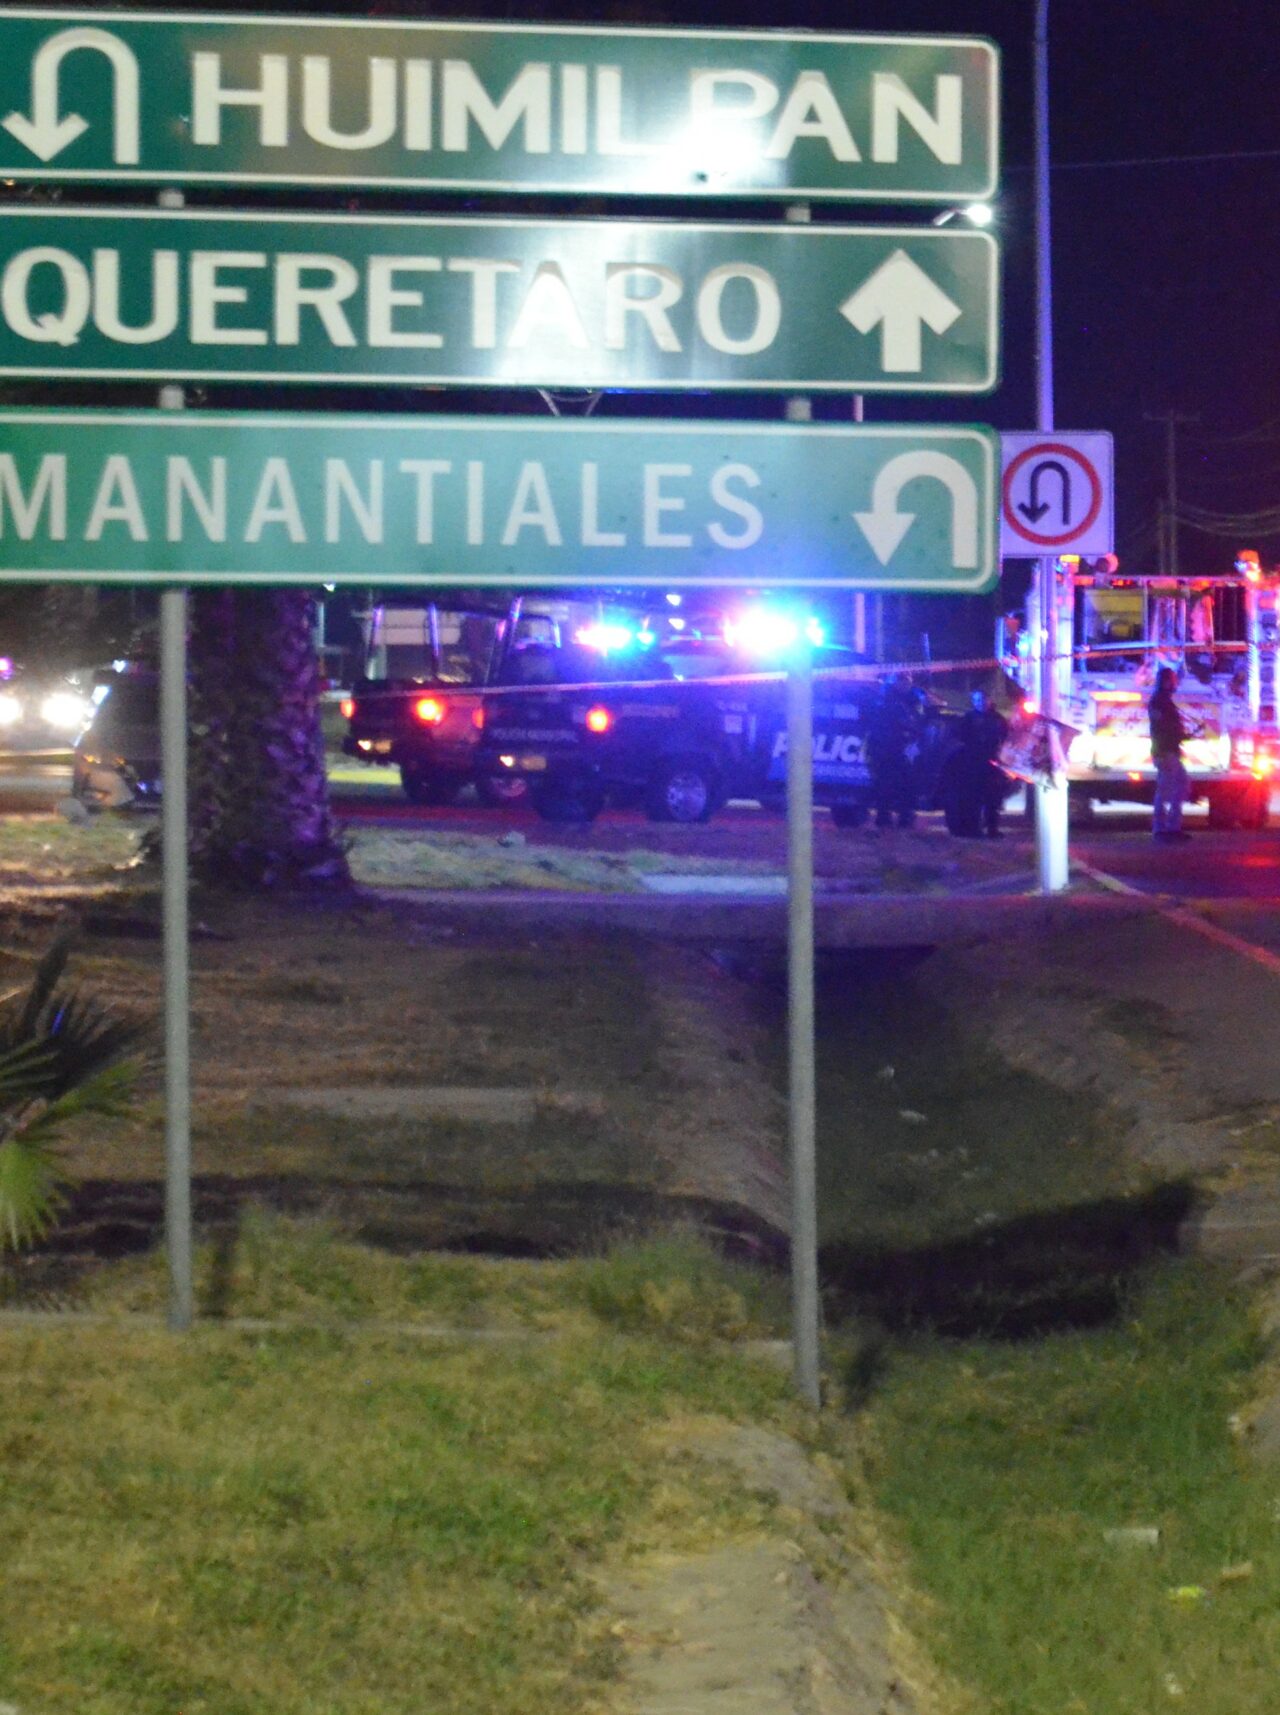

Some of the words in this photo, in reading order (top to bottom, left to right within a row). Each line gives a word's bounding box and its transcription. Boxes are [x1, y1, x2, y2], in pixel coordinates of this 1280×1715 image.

[192, 51, 964, 167] HUIMILPAN
[1, 245, 783, 356] QUERETARO
[0, 453, 764, 550] MANANTIALES
